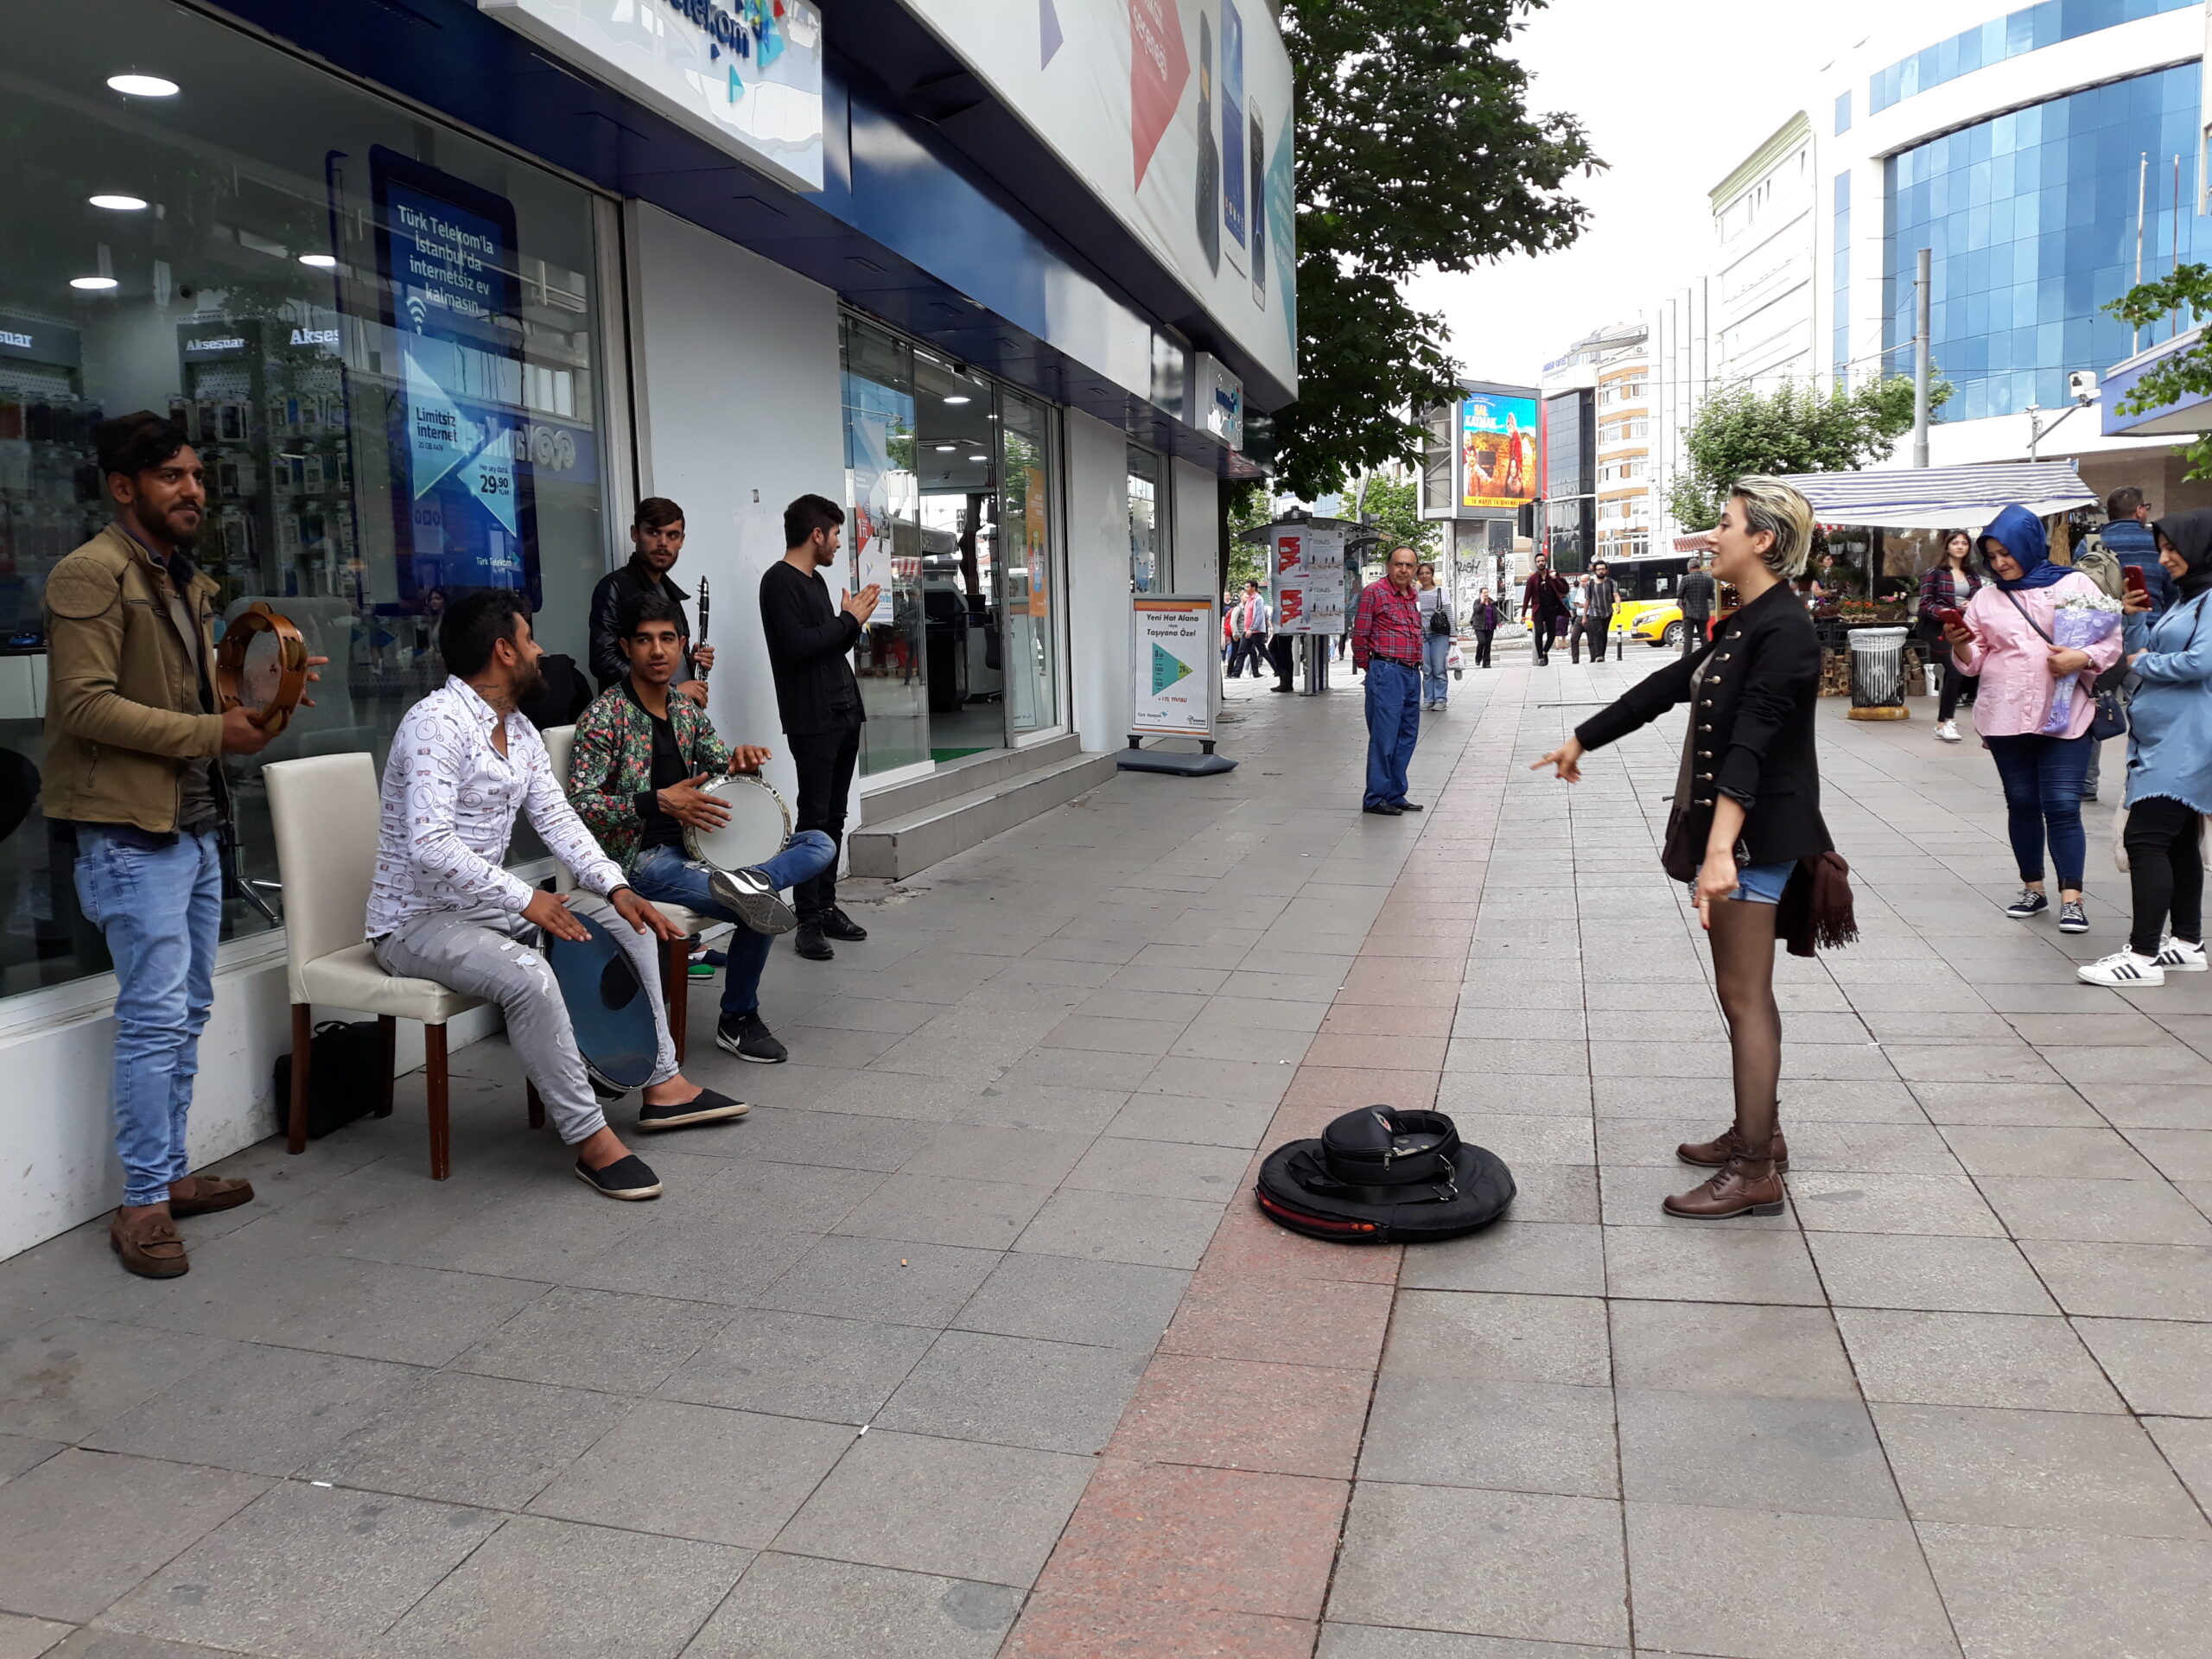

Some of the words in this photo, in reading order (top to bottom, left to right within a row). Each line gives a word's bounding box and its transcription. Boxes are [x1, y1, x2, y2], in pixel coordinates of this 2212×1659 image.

[397, 204, 428, 231] Türk
[429, 216, 493, 255] Telekom'la
[415, 230, 482, 271] İstanbul'da
[410, 254, 474, 290] internetsiz
[476, 283, 489, 296] ev
[425, 282, 479, 314] kalmasın
[186, 338, 245, 352] Aksesuar
[416, 406, 456, 427] Limitsiz
[417, 422, 458, 442] internet
[476, 556, 488, 566] Türk
[490, 557, 512, 567] Telekom
[1147, 628, 1179, 638] Taşıyana
[1179, 627, 1197, 637] Özel
